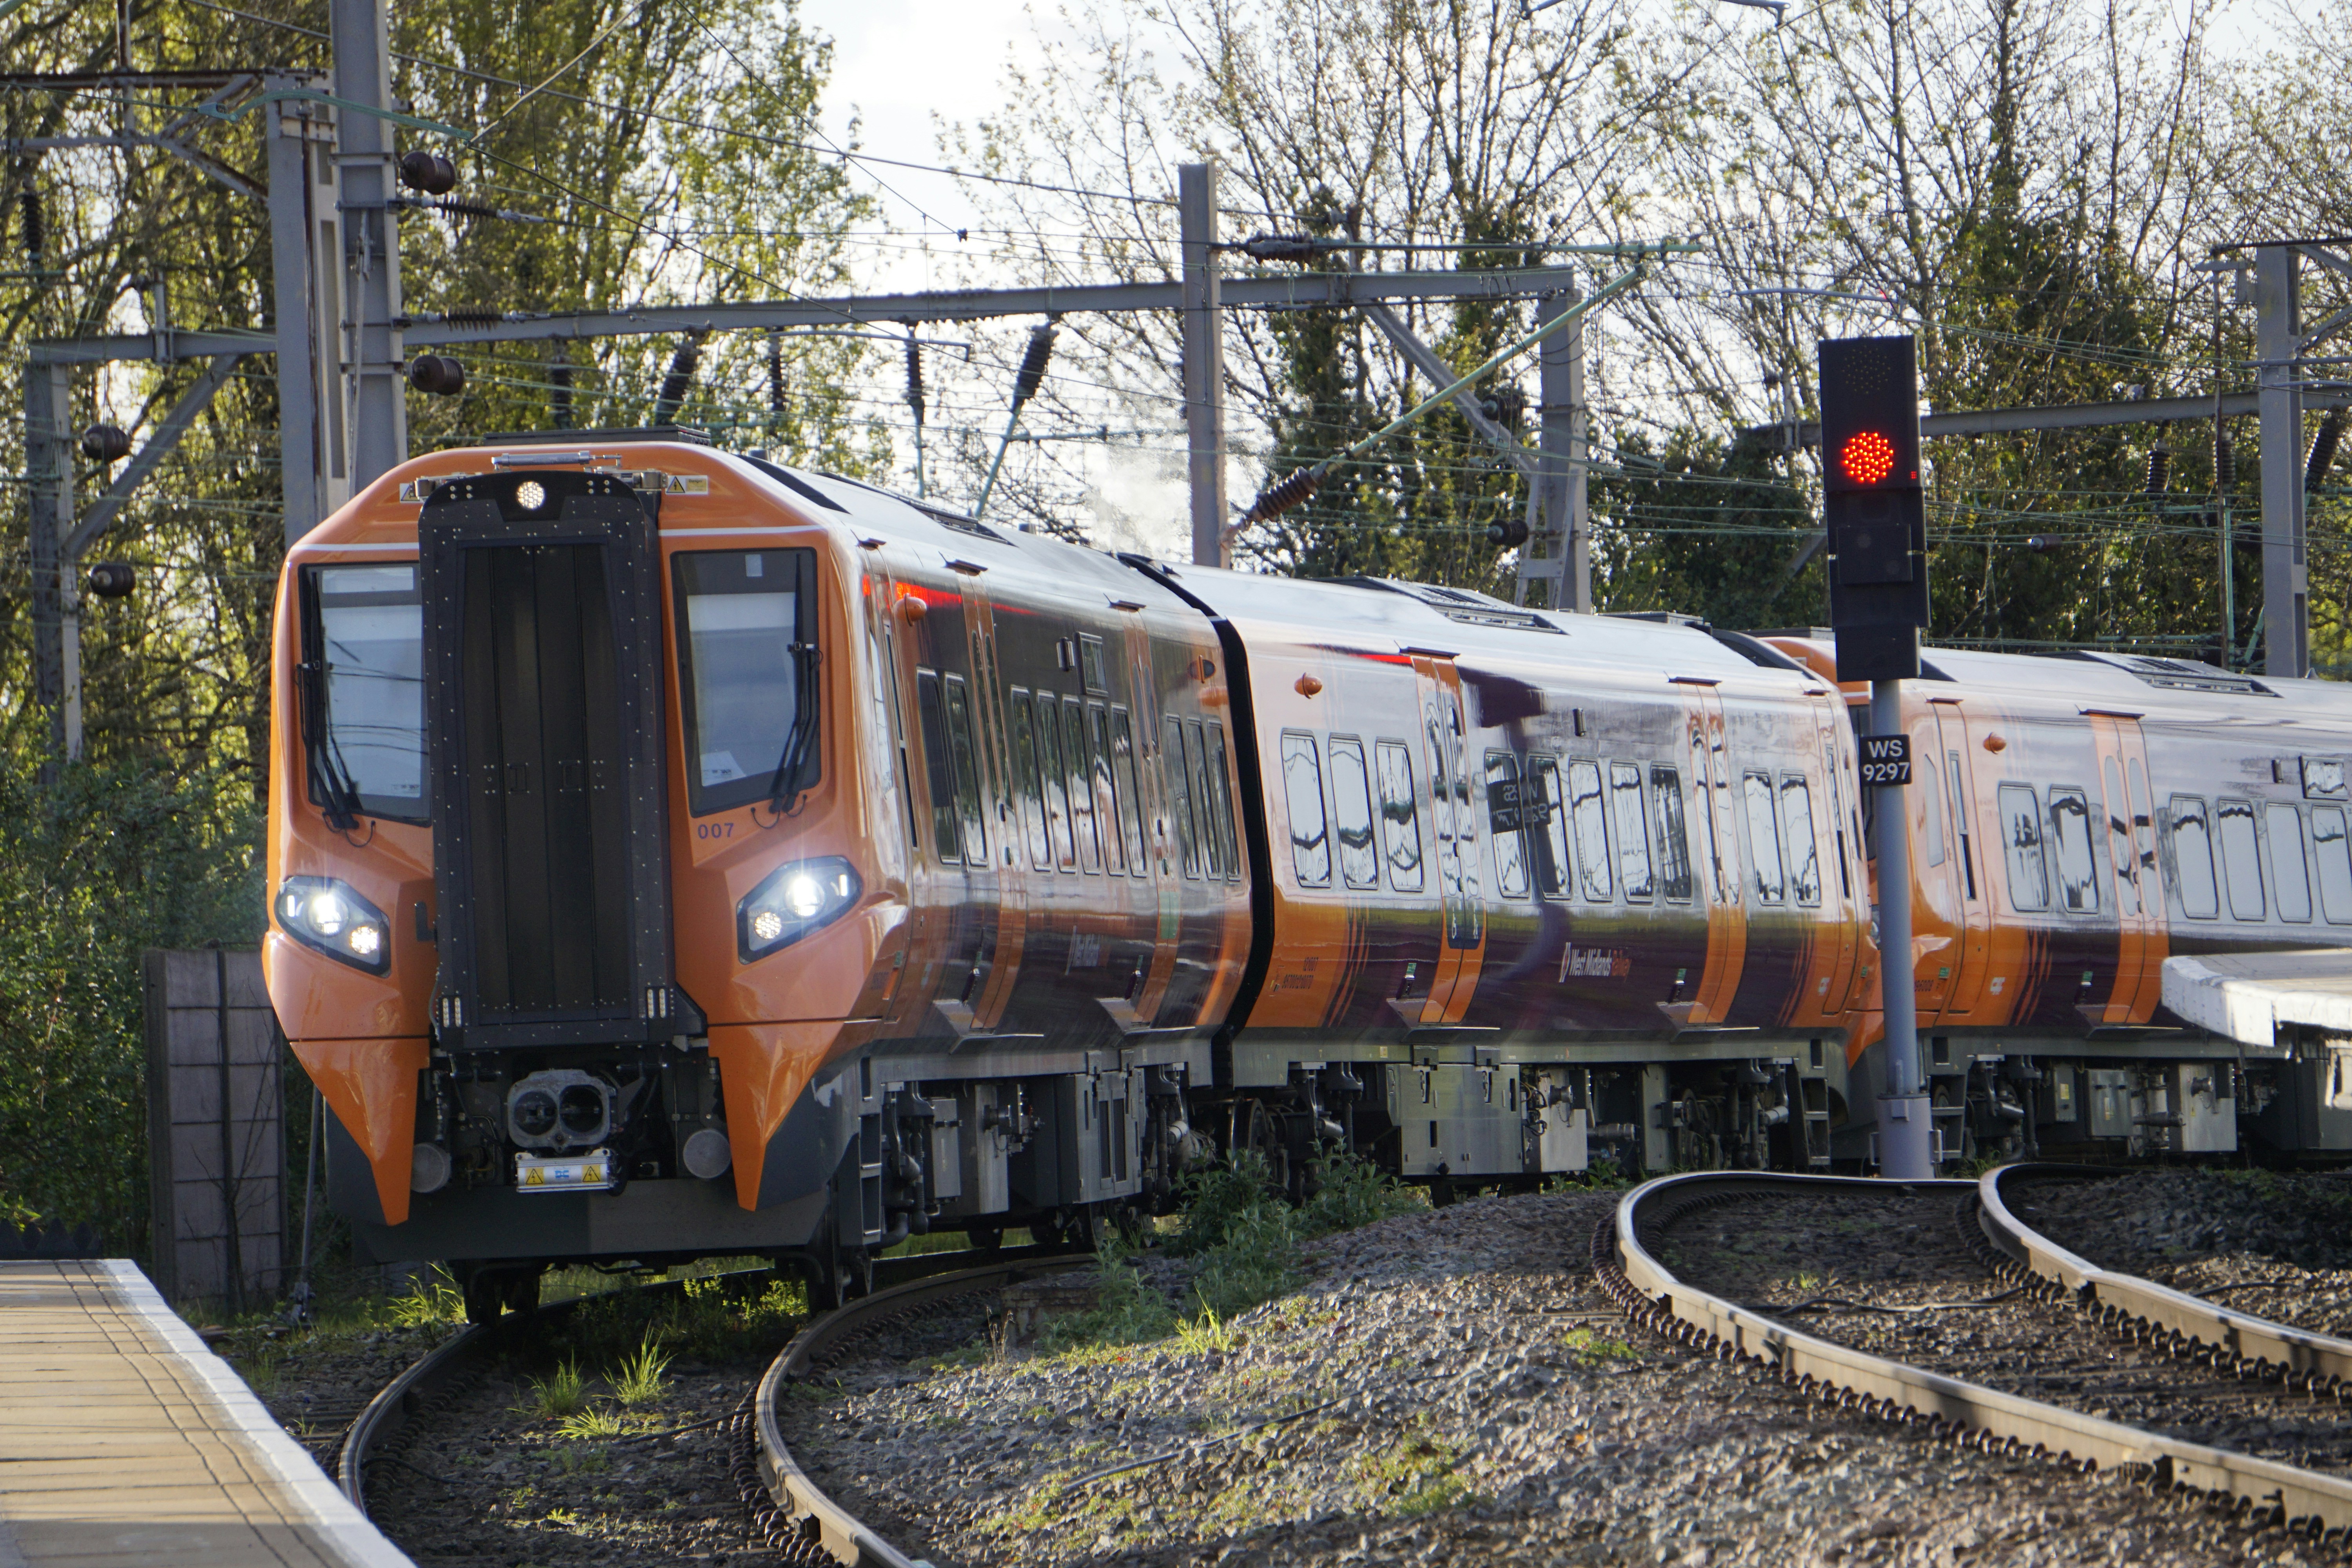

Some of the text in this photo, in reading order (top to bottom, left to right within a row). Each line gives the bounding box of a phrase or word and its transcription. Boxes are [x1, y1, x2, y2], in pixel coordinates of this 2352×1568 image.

[1868, 740, 1903, 758] WS
[1863, 762, 1910, 781] 9297
[698, 823, 734, 839] 007
[1569, 949, 1586, 976] West
[1584, 949, 1612, 976] Midlands
